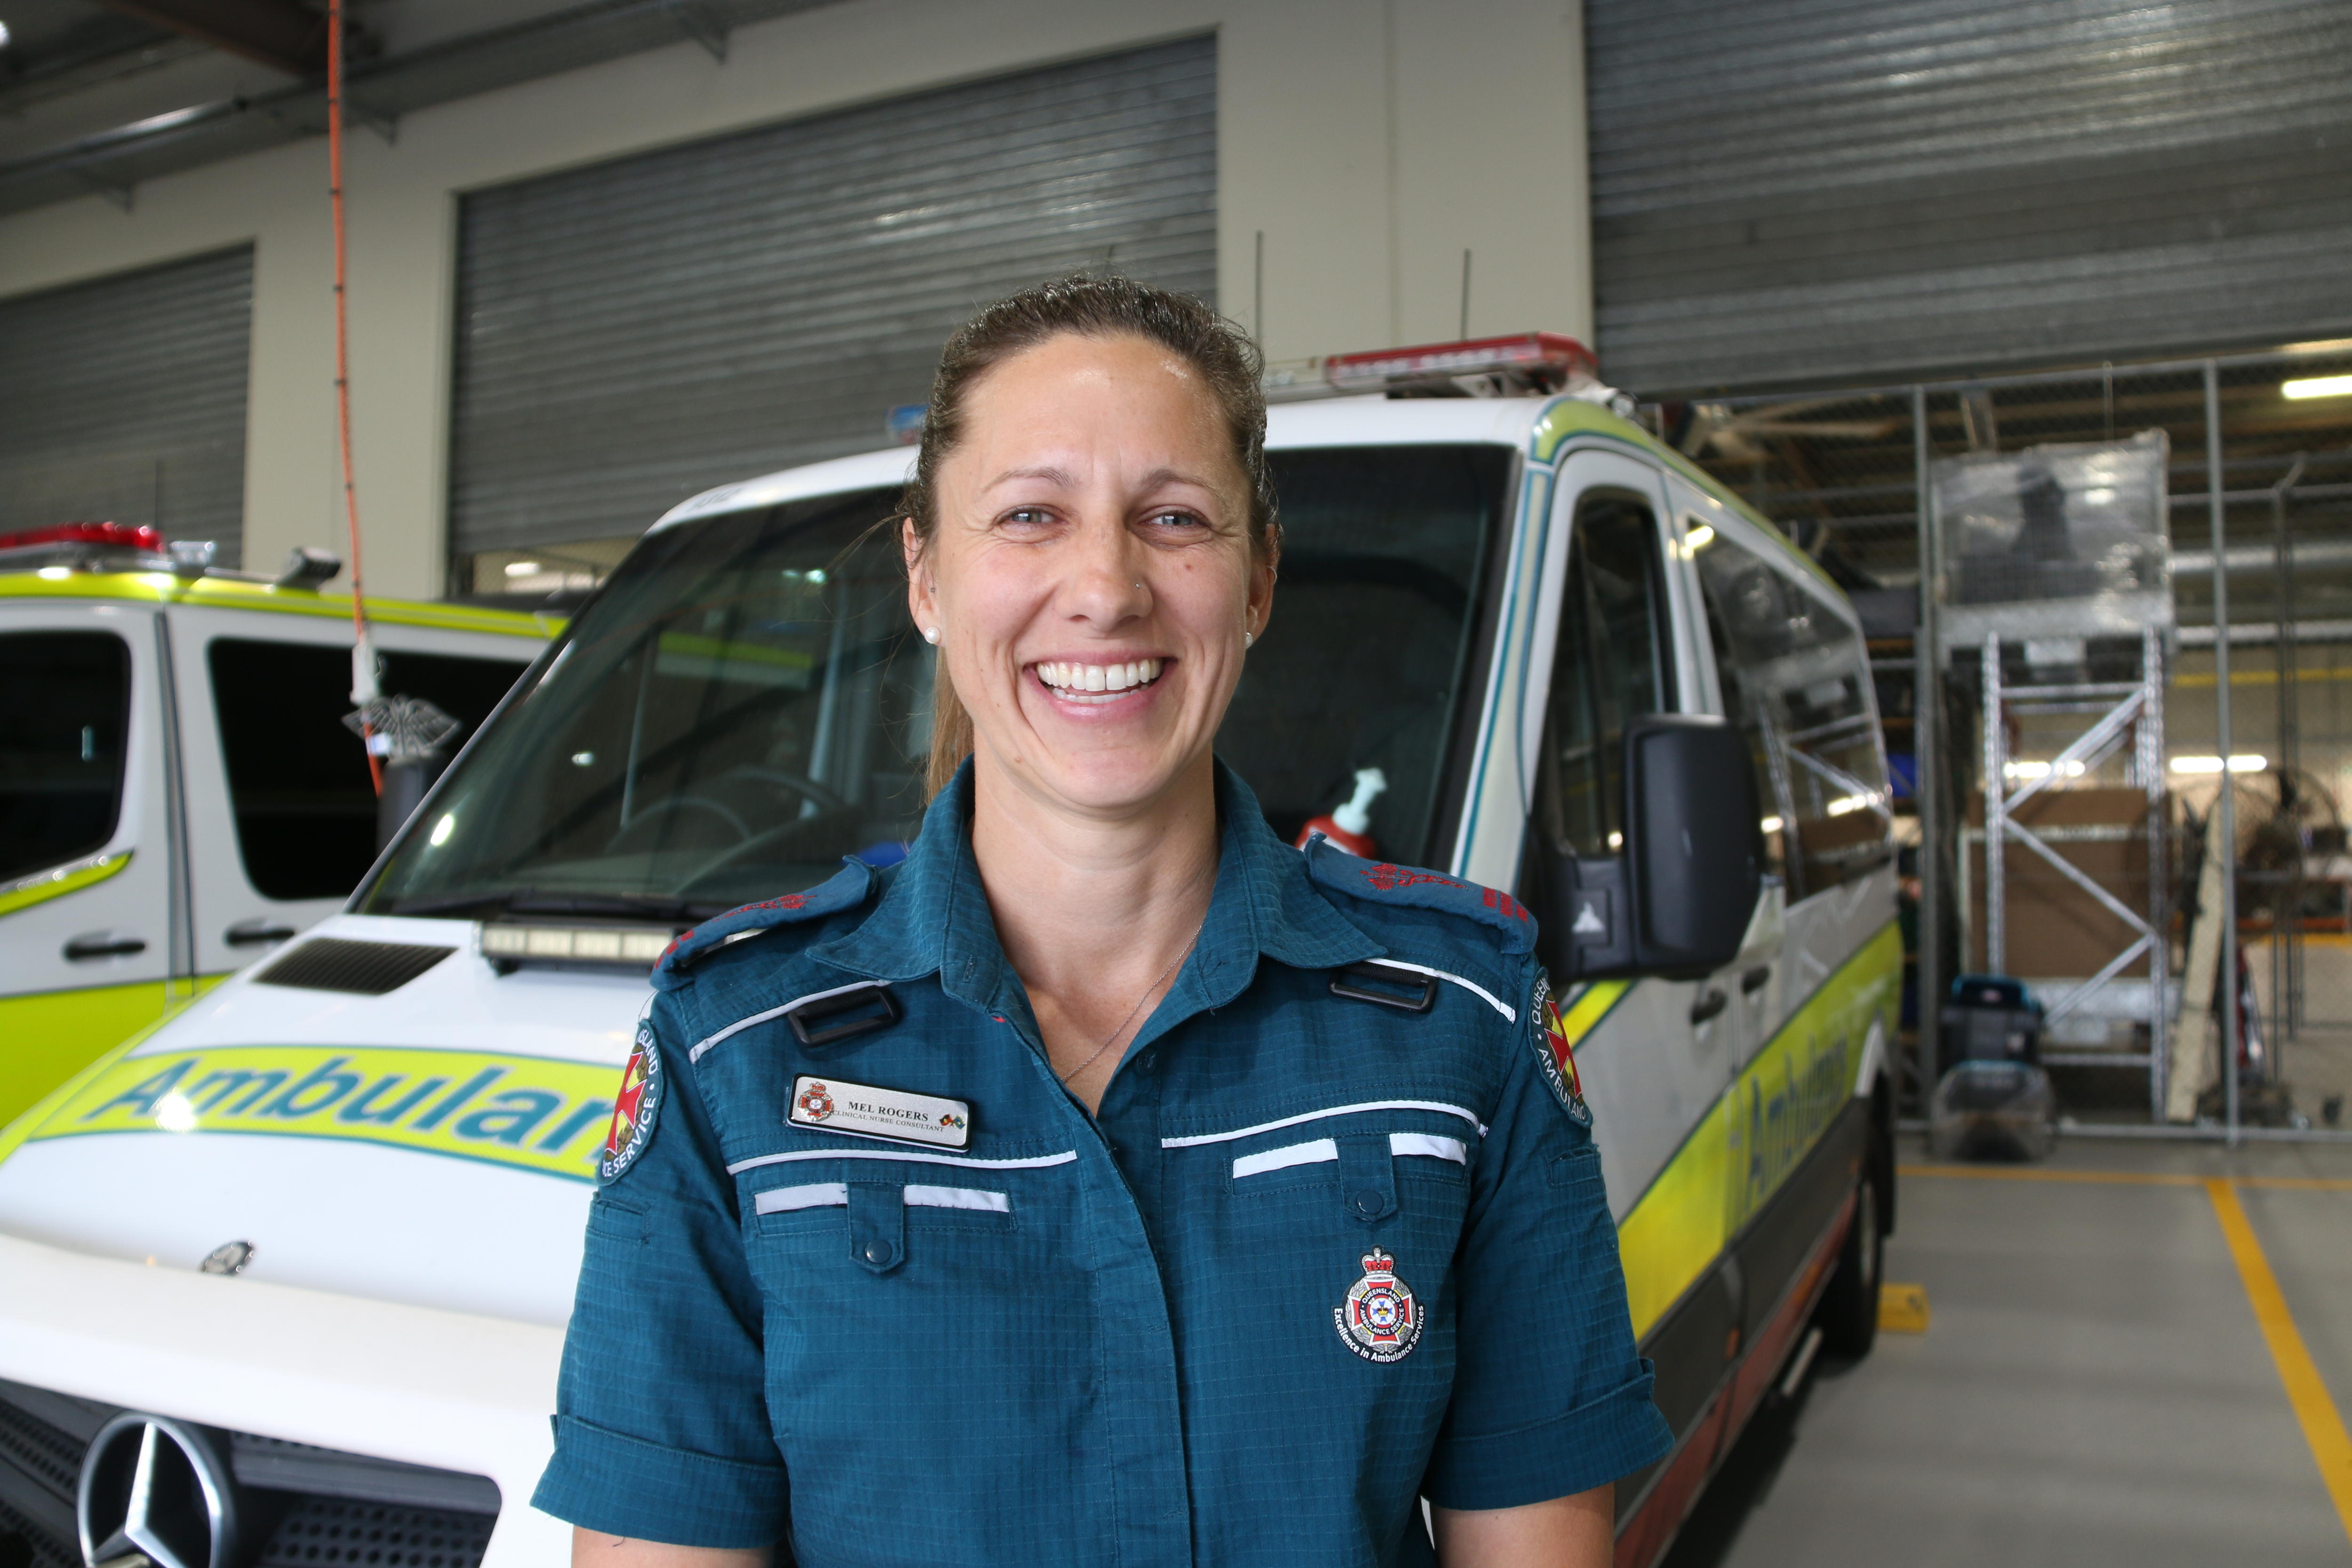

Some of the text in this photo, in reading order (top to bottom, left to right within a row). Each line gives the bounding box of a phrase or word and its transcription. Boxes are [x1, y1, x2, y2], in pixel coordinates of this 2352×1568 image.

[832, 1109, 945, 1132] CLINICAL NURSE CONSULTANT
[848, 1101, 929, 1122] MEL ROGERS
[613, 1097, 656, 1174] SERVICE
[1362, 1288, 1400, 1304] QUEENSLAND
[1334, 1305, 1424, 1362] Excellence in Ambulance Services
[1359, 1308, 1405, 1335] AMBULANCE SERVICE
